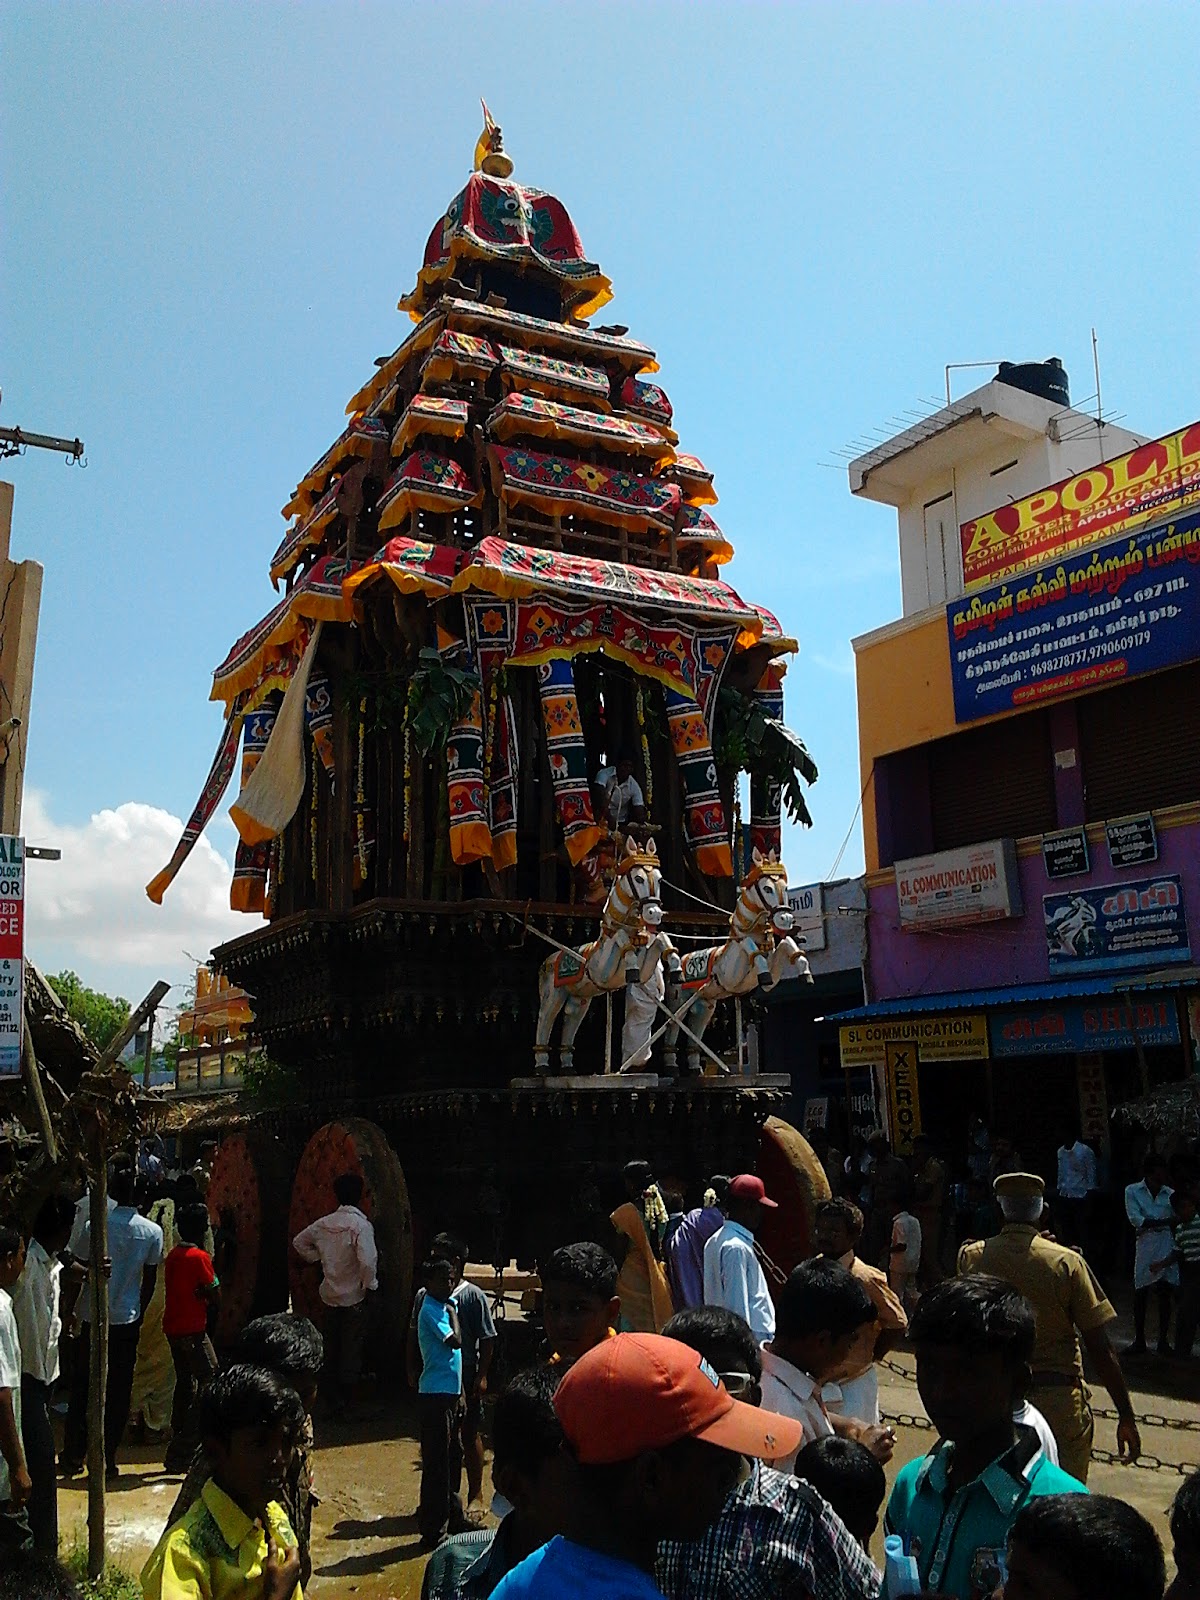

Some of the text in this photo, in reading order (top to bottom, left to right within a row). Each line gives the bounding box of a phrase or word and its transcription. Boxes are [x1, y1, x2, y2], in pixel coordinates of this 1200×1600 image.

[965, 428, 1200, 555] APOLL
[965, 459, 1200, 563] COMPUTER EDUCATIO
[1131, 489, 1180, 515] Success
[977, 556, 995, 570] part
[1008, 540, 1038, 556] MULTI
[1077, 498, 1136, 528] APOLLO
[1016, 565, 1068, 614] கல்வி
[1069, 538, 1144, 598] மற்றும்
[1133, 586, 1163, 605] 627
[900, 879, 913, 897] SL
[913, 862, 998, 894] COMMUNICATION
[848, 1019, 973, 1043] SL COMMUNICATION
[893, 1051, 916, 1146] XEROX
